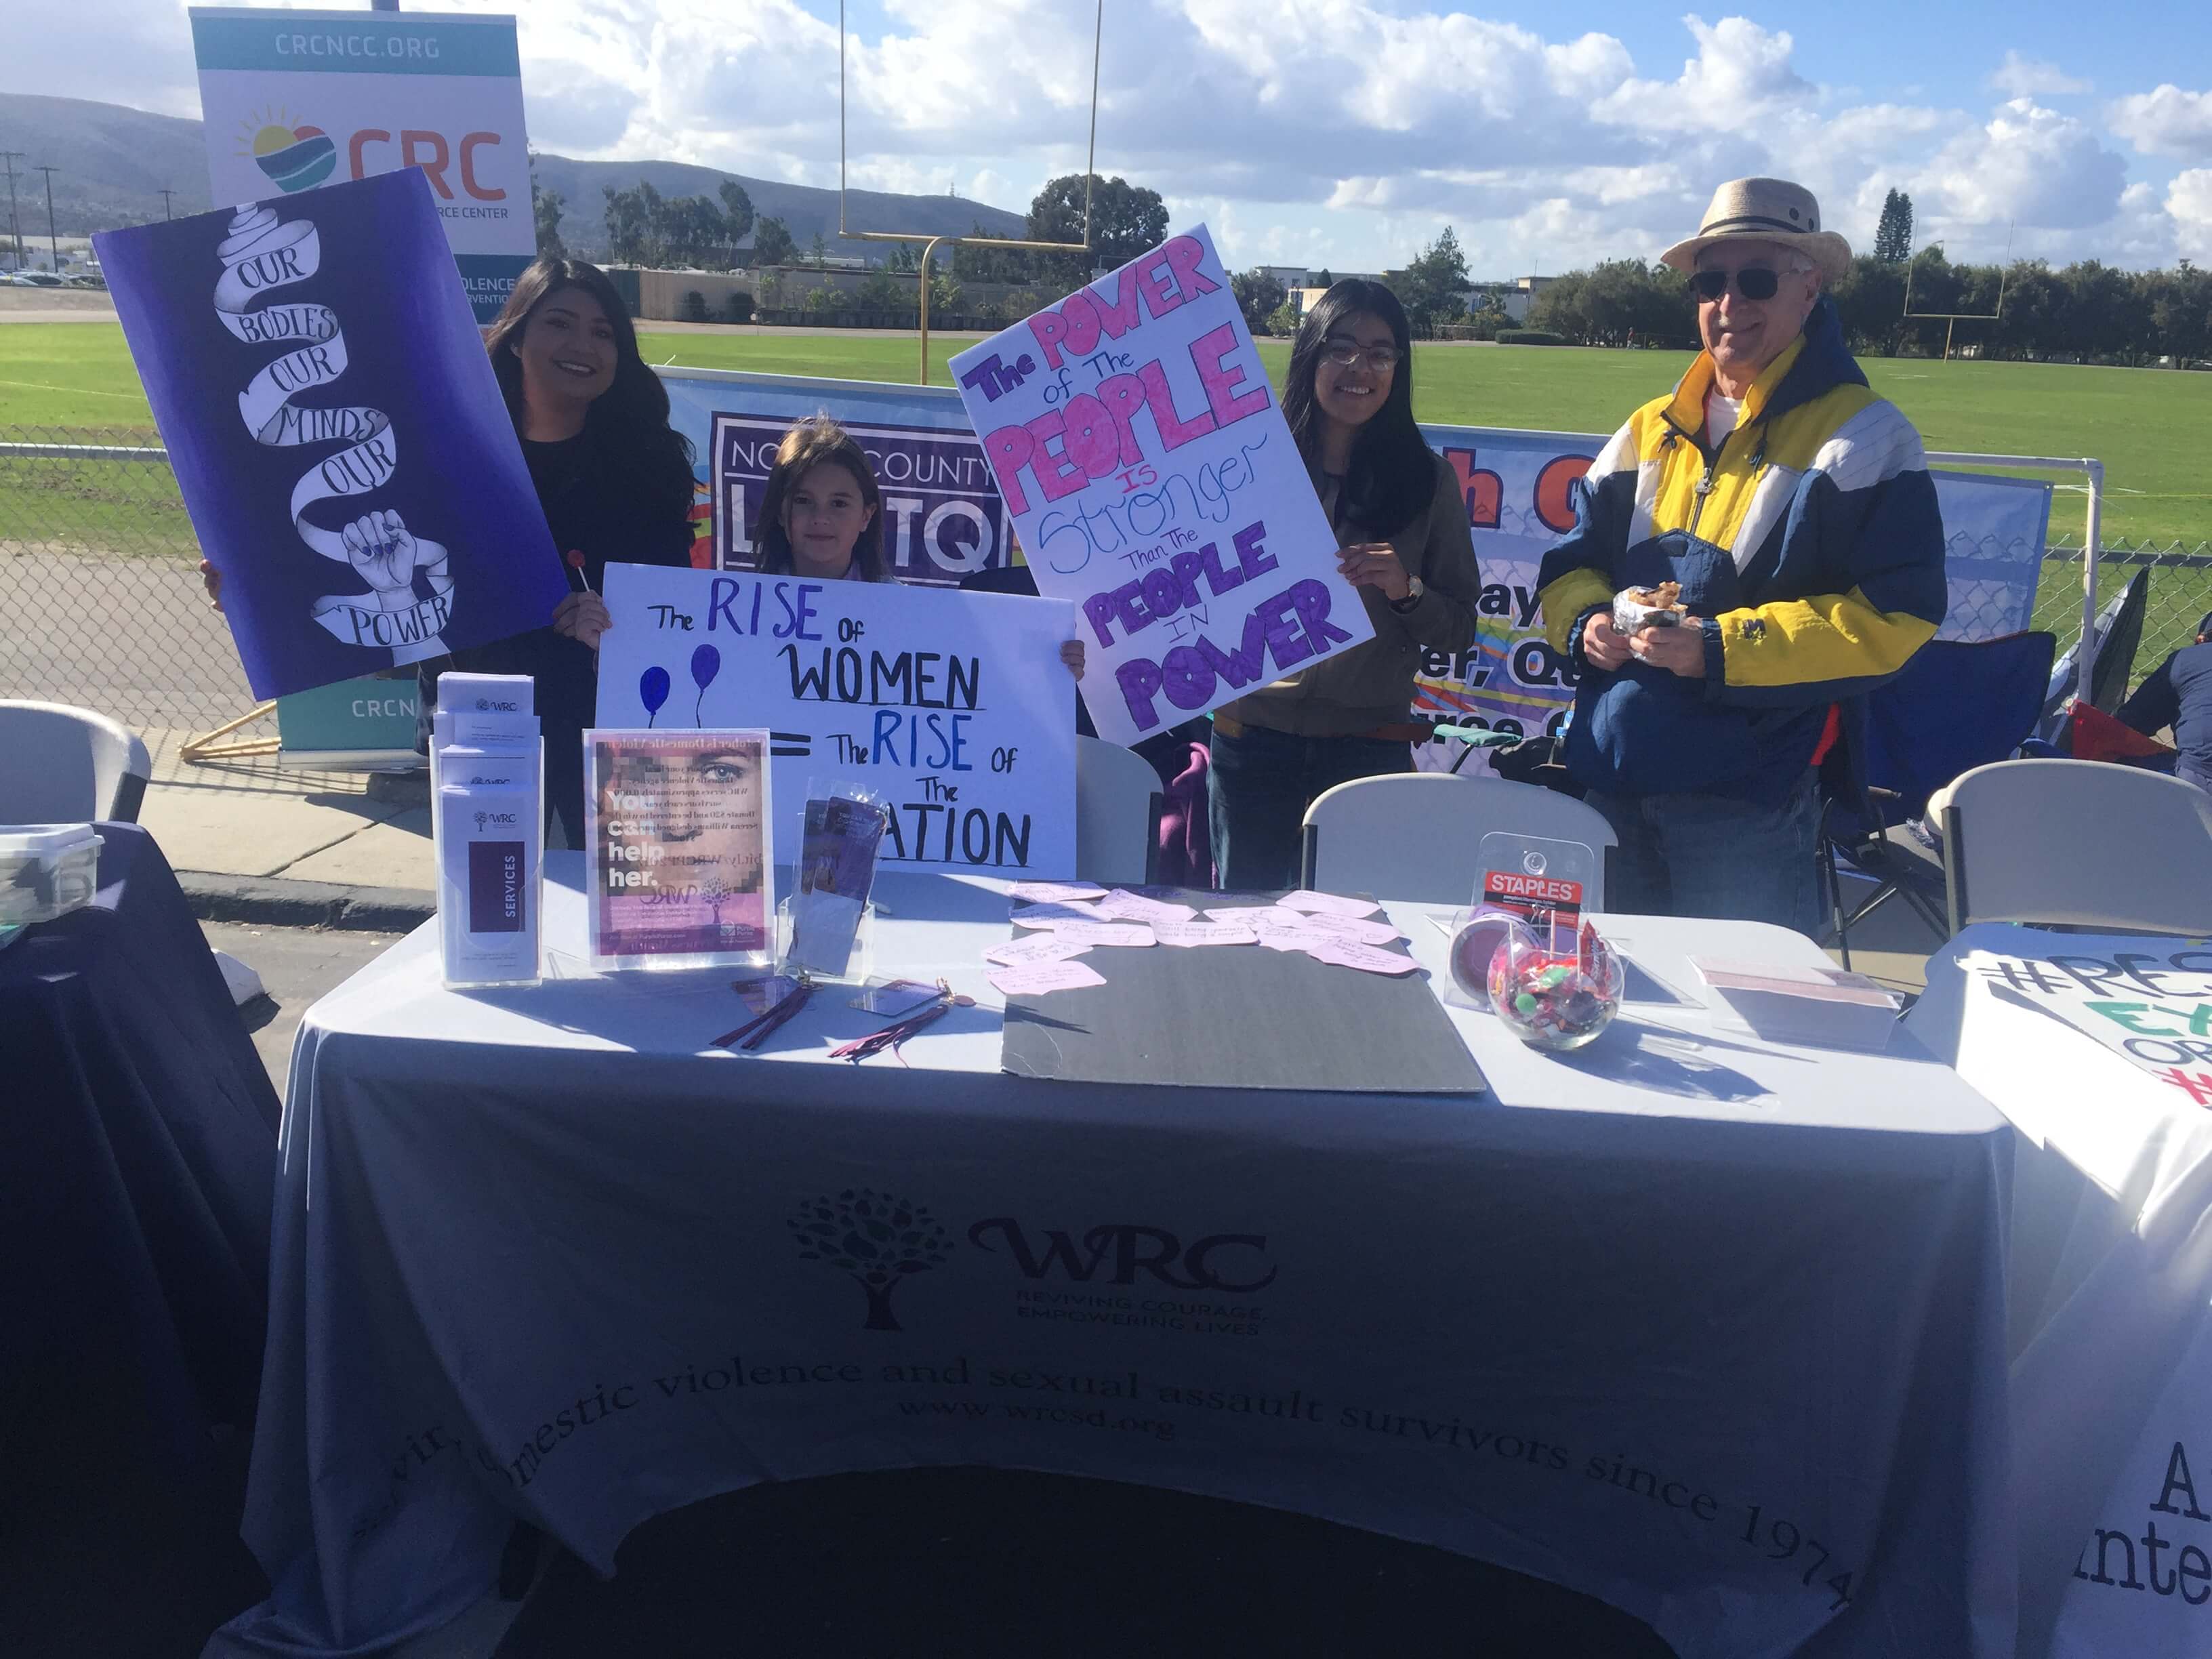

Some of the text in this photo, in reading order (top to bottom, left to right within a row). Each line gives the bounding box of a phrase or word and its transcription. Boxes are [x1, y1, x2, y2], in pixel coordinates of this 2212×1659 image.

[275, 33, 441, 58] CRCNCC.ORG
[348, 129, 507, 201] CRC
[462, 207, 508, 218] CENTER
[237, 247, 306, 289] OUR
[239, 308, 337, 343] BODIES
[960, 234, 1221, 403] The POWER
[269, 346, 337, 392] OUR
[1043, 350, 1134, 405] of The
[274, 407, 381, 444] MINDS
[983, 321, 1271, 518] PEOPLE
[321, 438, 396, 494] OUR
[1115, 464, 1158, 495] IS
[1118, 527, 1198, 571] Than The
[1082, 520, 1279, 649] PEOPLE
[348, 596, 449, 646] POWER
[647, 605, 694, 632] The
[708, 577, 823, 641] RISE
[1163, 605, 1210, 643] IN
[1115, 577, 1353, 732] POWER
[777, 643, 981, 710] WOMEN
[490, 702, 517, 712] WRC
[825, 733, 868, 765] The
[872, 710, 973, 771] RISE
[607, 791, 655, 811] You
[916, 776, 958, 802] The
[489, 813, 516, 823] WRC
[607, 820, 655, 836] can
[882, 803, 1031, 867] ATION
[609, 841, 665, 866] help
[505, 855, 516, 918] SERVICES
[609, 867, 658, 887] her.
[1492, 874, 1572, 901] STAPLES
[968, 1216, 1278, 1293] WRC
[1017, 1290, 1132, 1311] REVIVING
[1017, 1306, 1259, 1336] EMPOWERING LIVES
[477, 1382, 639, 1486] mestic
[654, 1357, 864, 1399] violence
[883, 1357, 972, 1387] and
[989, 1366, 1140, 1400] sexual
[1158, 1382, 1325, 1424] assault
[1340, 1407, 1569, 1471] survivors
[1584, 1453, 1719, 1523] since
[1739, 1504, 1854, 1612] 1974
